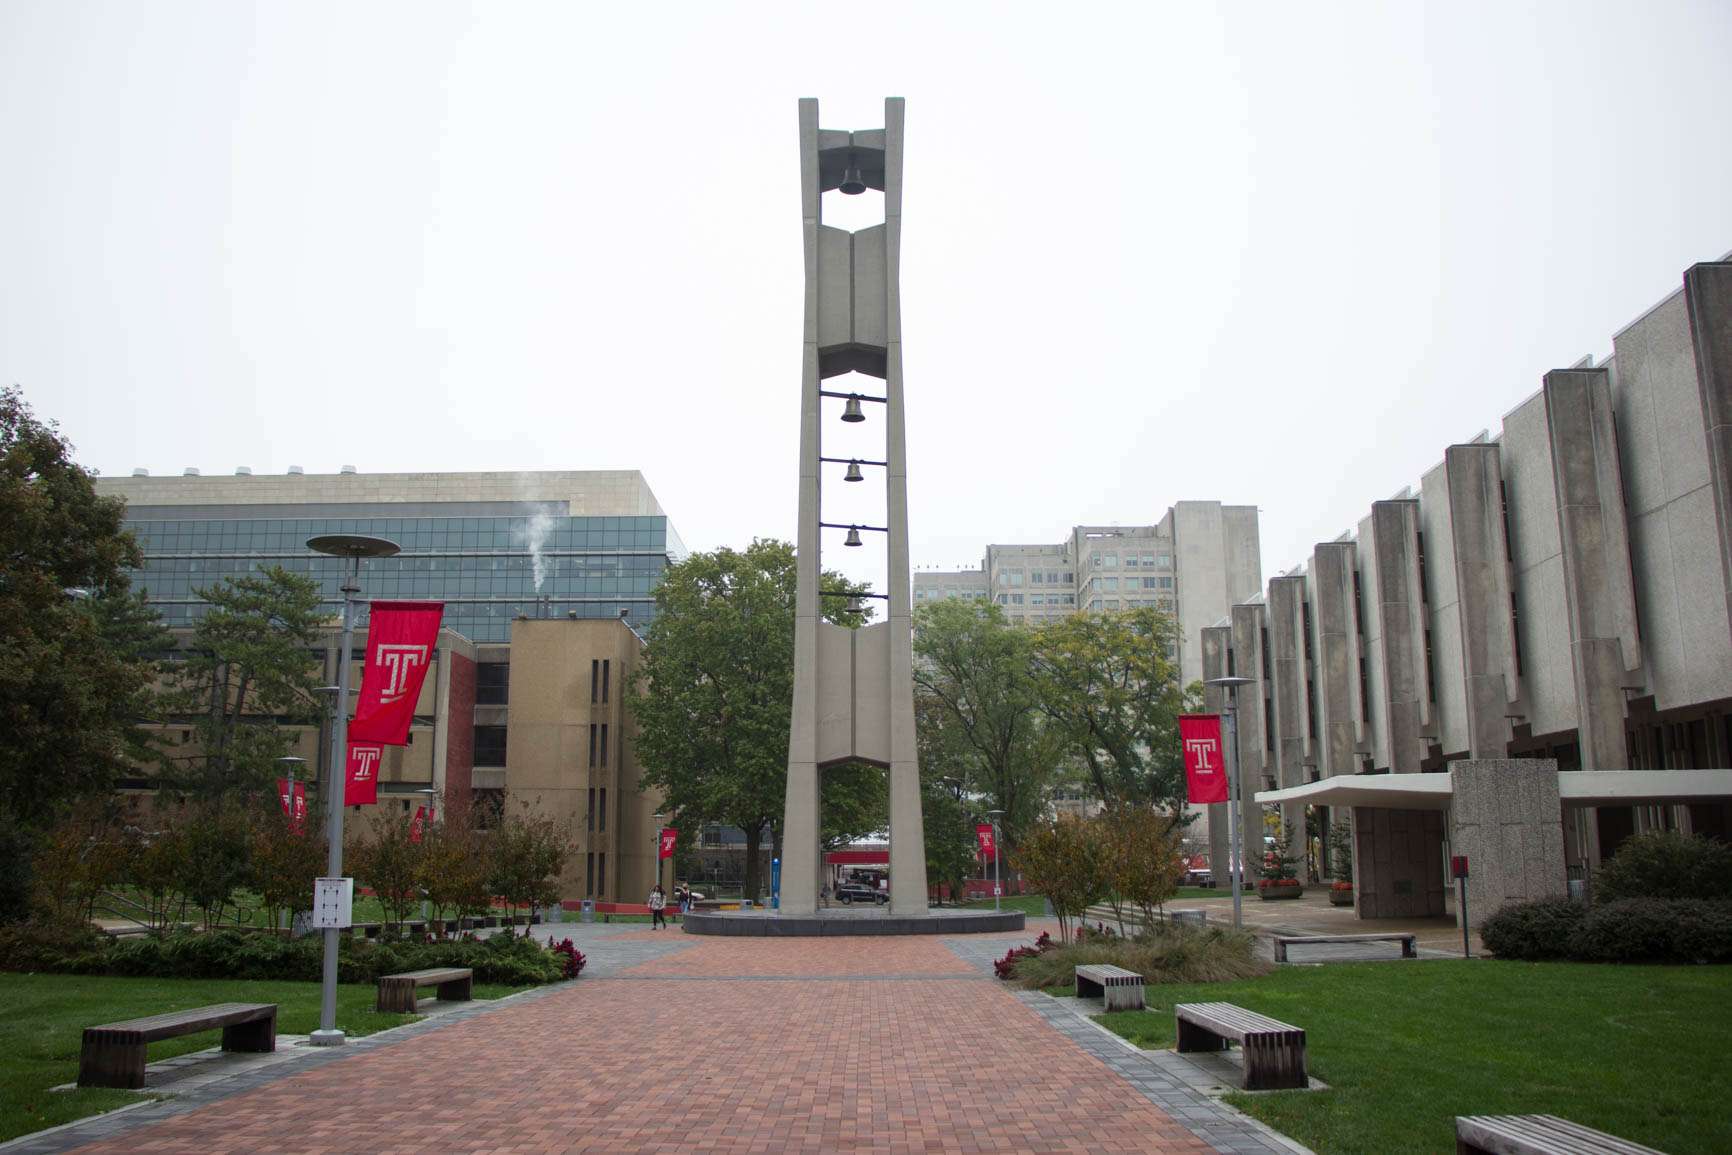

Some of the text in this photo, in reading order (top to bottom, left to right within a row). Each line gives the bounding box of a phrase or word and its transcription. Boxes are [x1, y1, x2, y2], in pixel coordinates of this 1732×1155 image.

[376, 644, 428, 704] T
[353, 747, 380, 780] T
[1186, 739, 1216, 774] T
